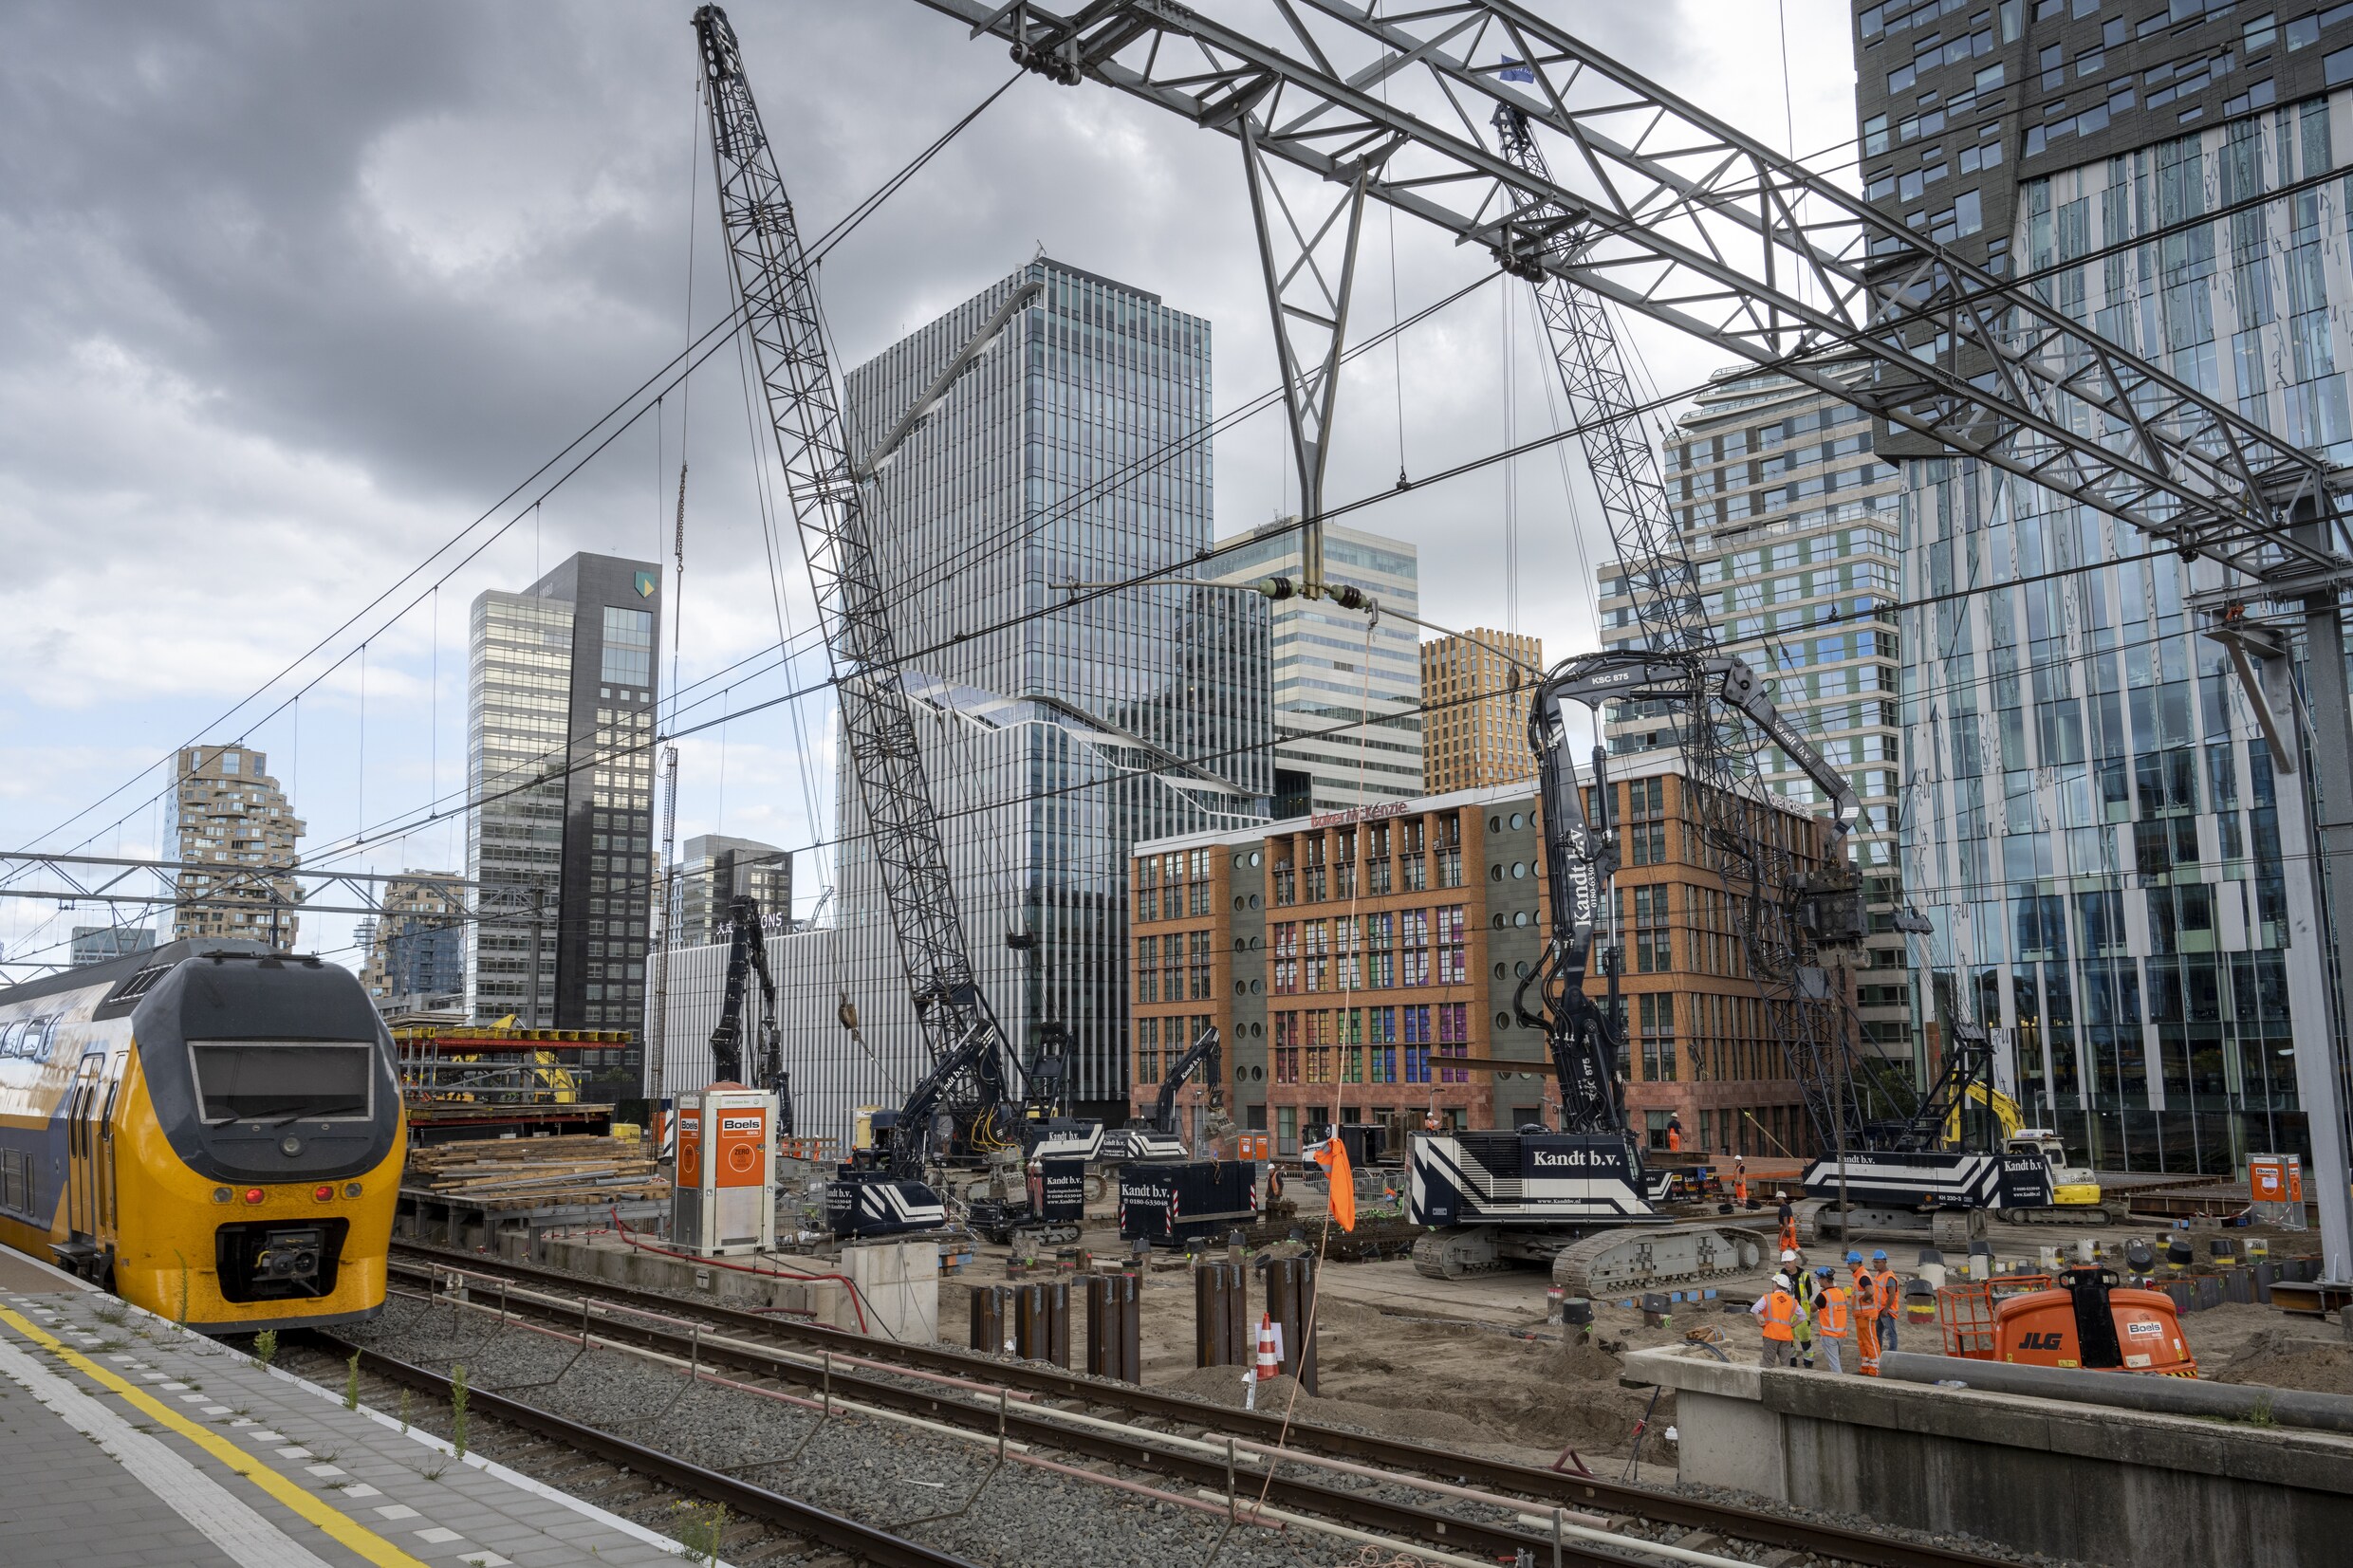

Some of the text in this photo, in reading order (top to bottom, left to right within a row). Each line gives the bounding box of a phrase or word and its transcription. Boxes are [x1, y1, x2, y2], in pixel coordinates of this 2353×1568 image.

[1592, 673, 1629, 685] KSC 875
[1568, 864, 1591, 928] Kandt
[1582, 1057, 1593, 1076] 875
[935, 1076, 955, 1100] Kndt
[681, 1120, 698, 1130] Boels
[724, 1119, 760, 1129] Boels
[1048, 1131, 1066, 1141] Kandt
[1533, 1150, 1621, 1166] Kandt b.v.
[1861, 1154, 1876, 1165] b.v.
[2004, 1158, 2044, 1171] Kandt b.v.
[1047, 1176, 1083, 1185] Kandt b.v.
[839, 1188, 852, 1198] b.v.
[1121, 1184, 1170, 1198] Kandt b.v.
[1129, 1198, 1168, 1207] 0180-633048
[2129, 1323, 2160, 1333] Boels
